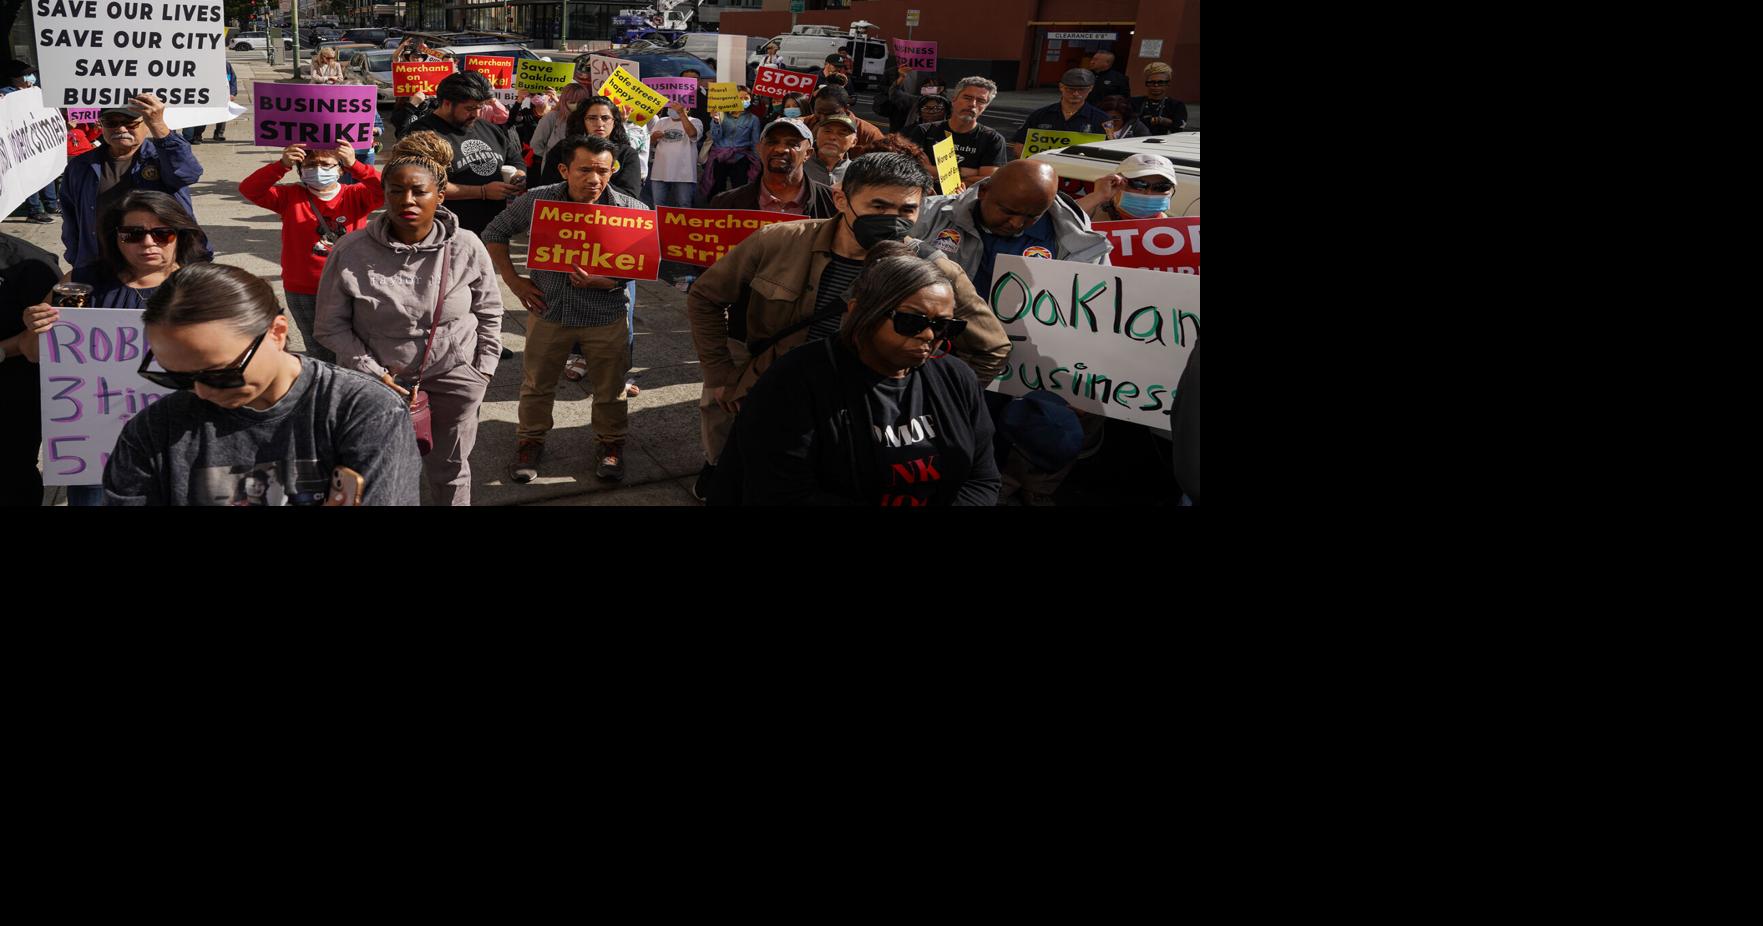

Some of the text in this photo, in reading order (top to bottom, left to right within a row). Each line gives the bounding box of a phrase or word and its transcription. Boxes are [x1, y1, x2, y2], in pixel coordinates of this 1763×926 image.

[37, 0, 221, 22] SAVE OUR LIVES
[40, 29, 222, 50] SAVE OUR CITY
[75, 59, 196, 77] SAVE OUR
[395, 64, 449, 73] Merchants
[468, 58, 511, 67] Merchants
[521, 61, 553, 73] Save
[592, 59, 630, 76] SAV
[519, 72, 567, 83] Oakland
[614, 70, 632, 87] Safe
[761, 70, 813, 88] STOP
[397, 80, 438, 93] strik
[646, 83, 695, 91] USINESS
[259, 96, 372, 113] BUSINESS
[608, 78, 634, 102] happy
[635, 99, 655, 114] eats
[71, 111, 101, 121] STRI
[260, 120, 370, 144] STRIKE
[1031, 132, 1071, 145] Save
[539, 206, 654, 230] Merchants
[664, 211, 784, 230] Merchan
[558, 228, 586, 241] on
[688, 232, 719, 244] on
[534, 243, 646, 271] strike!
[666, 244, 737, 262] stri
[47, 321, 150, 364] ROB
[49, 376, 85, 423] 3
[48, 435, 89, 475] 5
